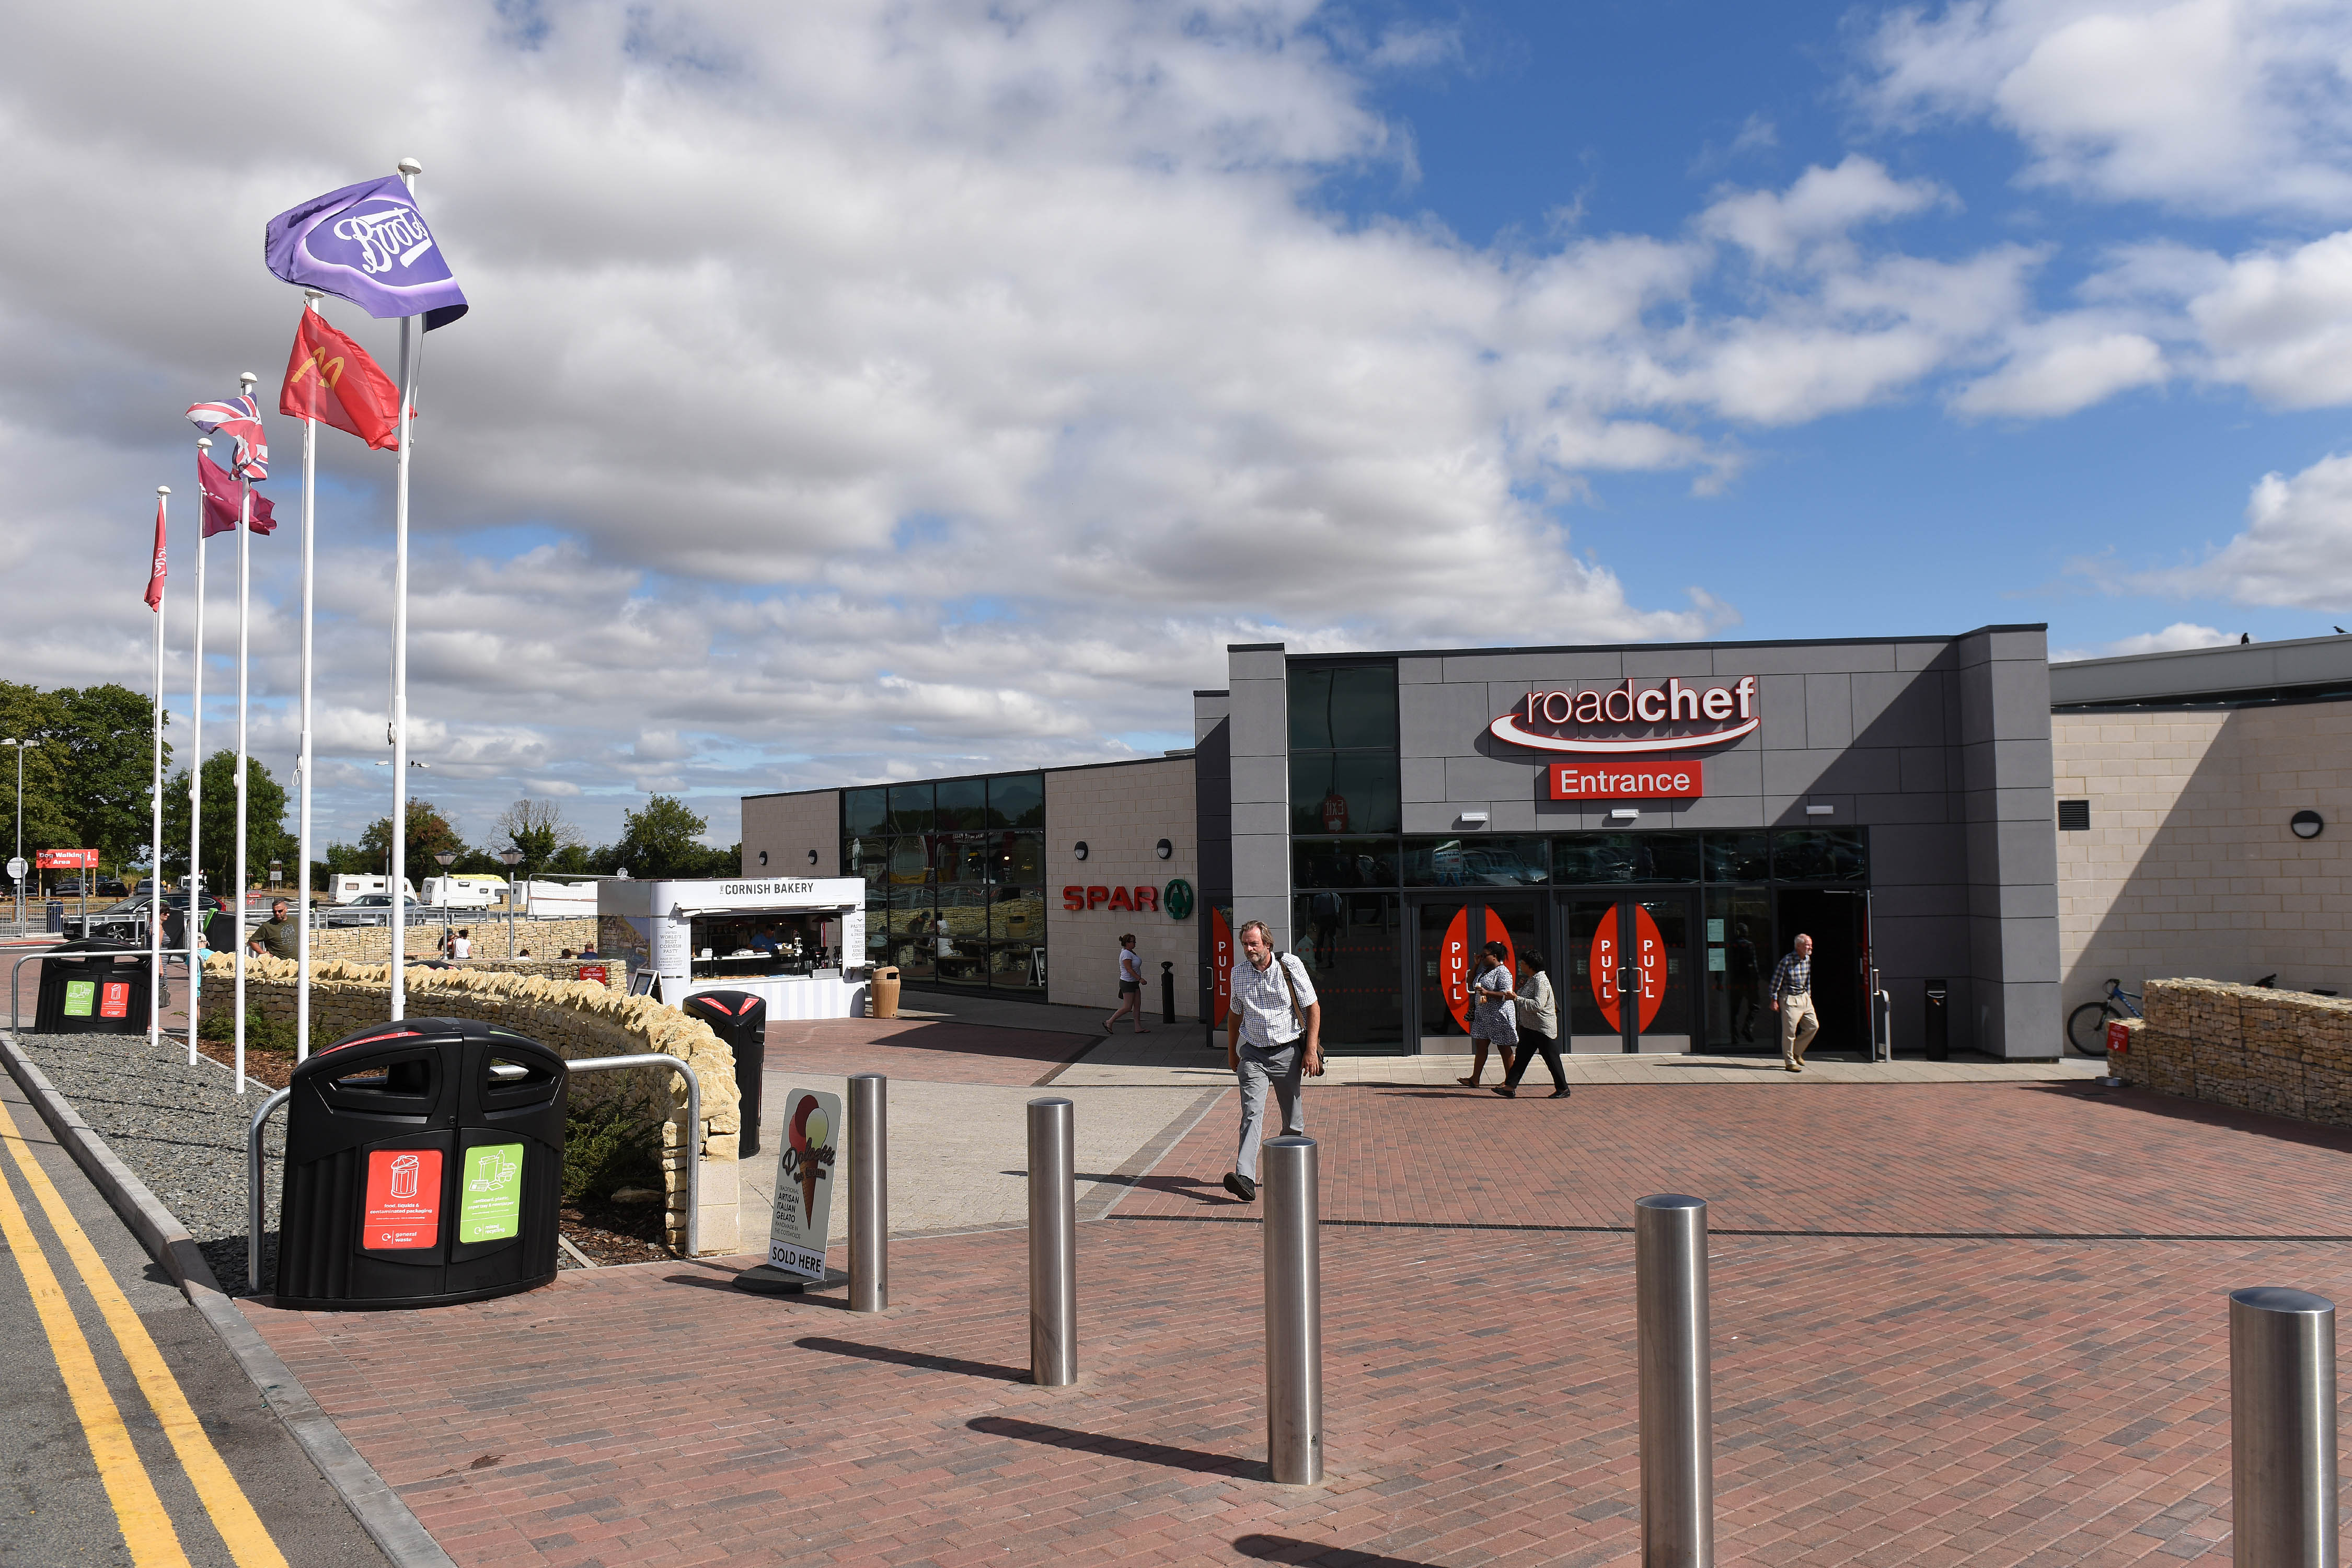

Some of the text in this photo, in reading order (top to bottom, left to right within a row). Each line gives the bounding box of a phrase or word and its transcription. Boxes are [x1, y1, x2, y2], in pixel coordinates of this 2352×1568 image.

[334, 207, 433, 274] Boots
[1527, 676, 1755, 723] roadchef
[1561, 769, 1690, 793] Entrance
[725, 884, 770, 895] CORNISH
[774, 882, 814, 894] BAKERY
[1063, 885, 1158, 912] SPAR
[1218, 941, 1227, 996] PULL
[1451, 942, 1461, 999] PULL
[1601, 940, 1611, 998] PULL
[1643, 940, 1654, 998] PULL
[778, 1192, 799, 1204] ARTISAN
[779, 1185, 799, 1194] TRADITIONAL
[776, 1211, 795, 1223] GELATO
[777, 1202, 795, 1213] ITALIAN
[775, 1220, 794, 1230] HANDMADE
[780, 1229, 801, 1239] COTSWOLDS
[772, 1246, 822, 1273] SOLD HERE
